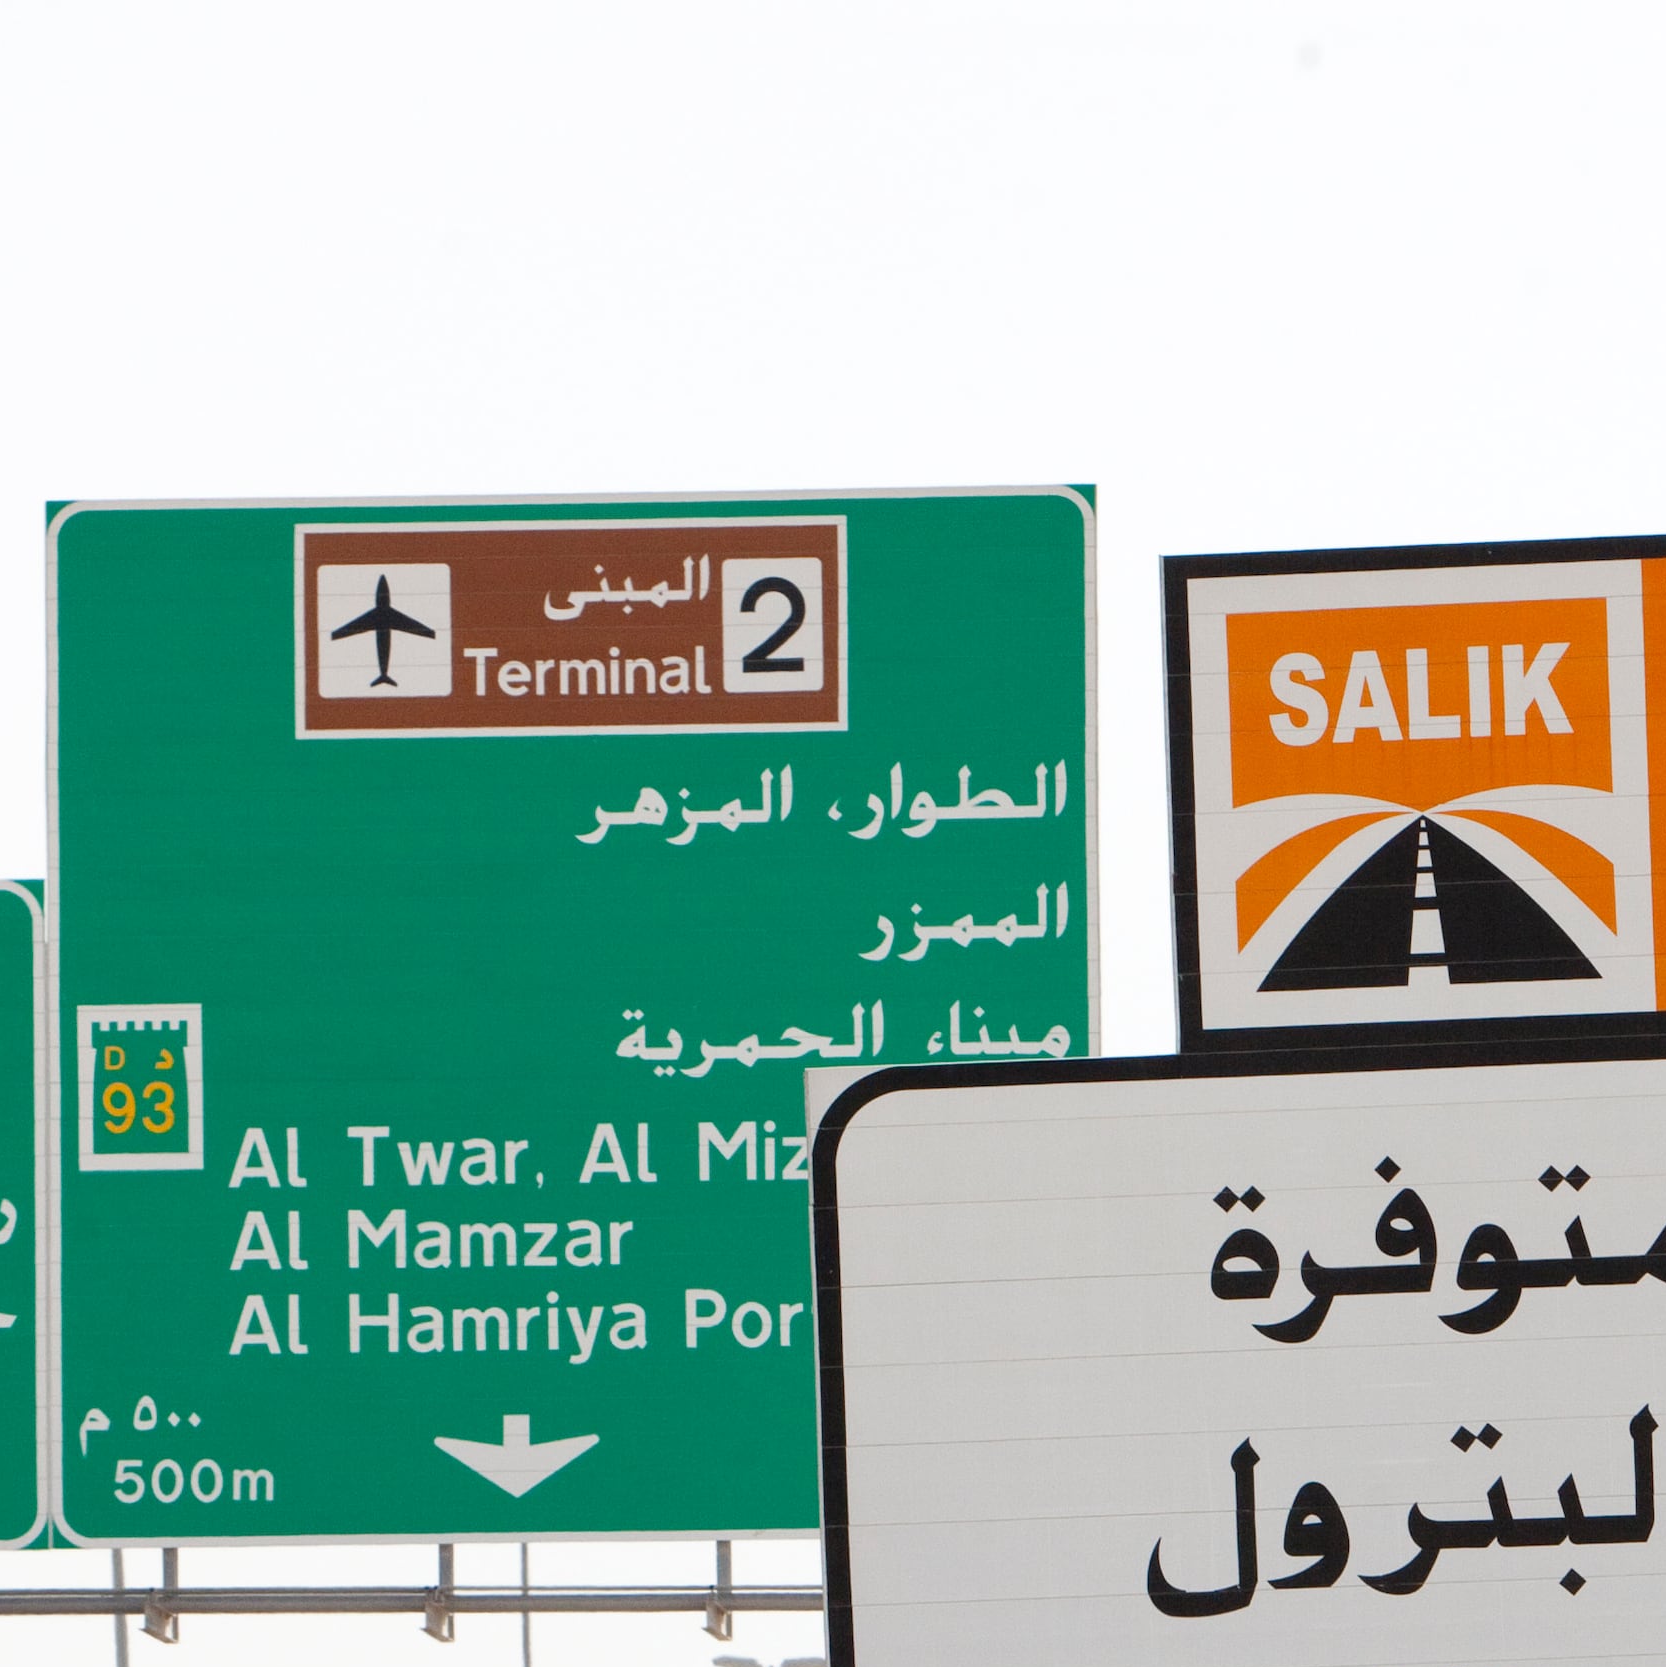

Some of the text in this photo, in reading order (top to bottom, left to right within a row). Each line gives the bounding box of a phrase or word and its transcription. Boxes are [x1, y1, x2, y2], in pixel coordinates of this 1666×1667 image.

[543, 554, 711, 621] المبنى
[740, 576, 806, 674] 2
[463, 645, 712, 697] Terminal
[1269, 642, 1574, 747] SALIK
[575, 764, 794, 846] المزهر
[859, 881, 1069, 962] الممزر
[104, 1045, 126, 1071] D
[102, 1081, 175, 1134] 93
[228, 1127, 308, 1188] Al
[579, 1122, 658, 1184] Al
[229, 1208, 634, 1271] Al Mamzar
[229, 1287, 812, 1365] Al Hamriya Por
[114, 1458, 274, 1504] 500m
